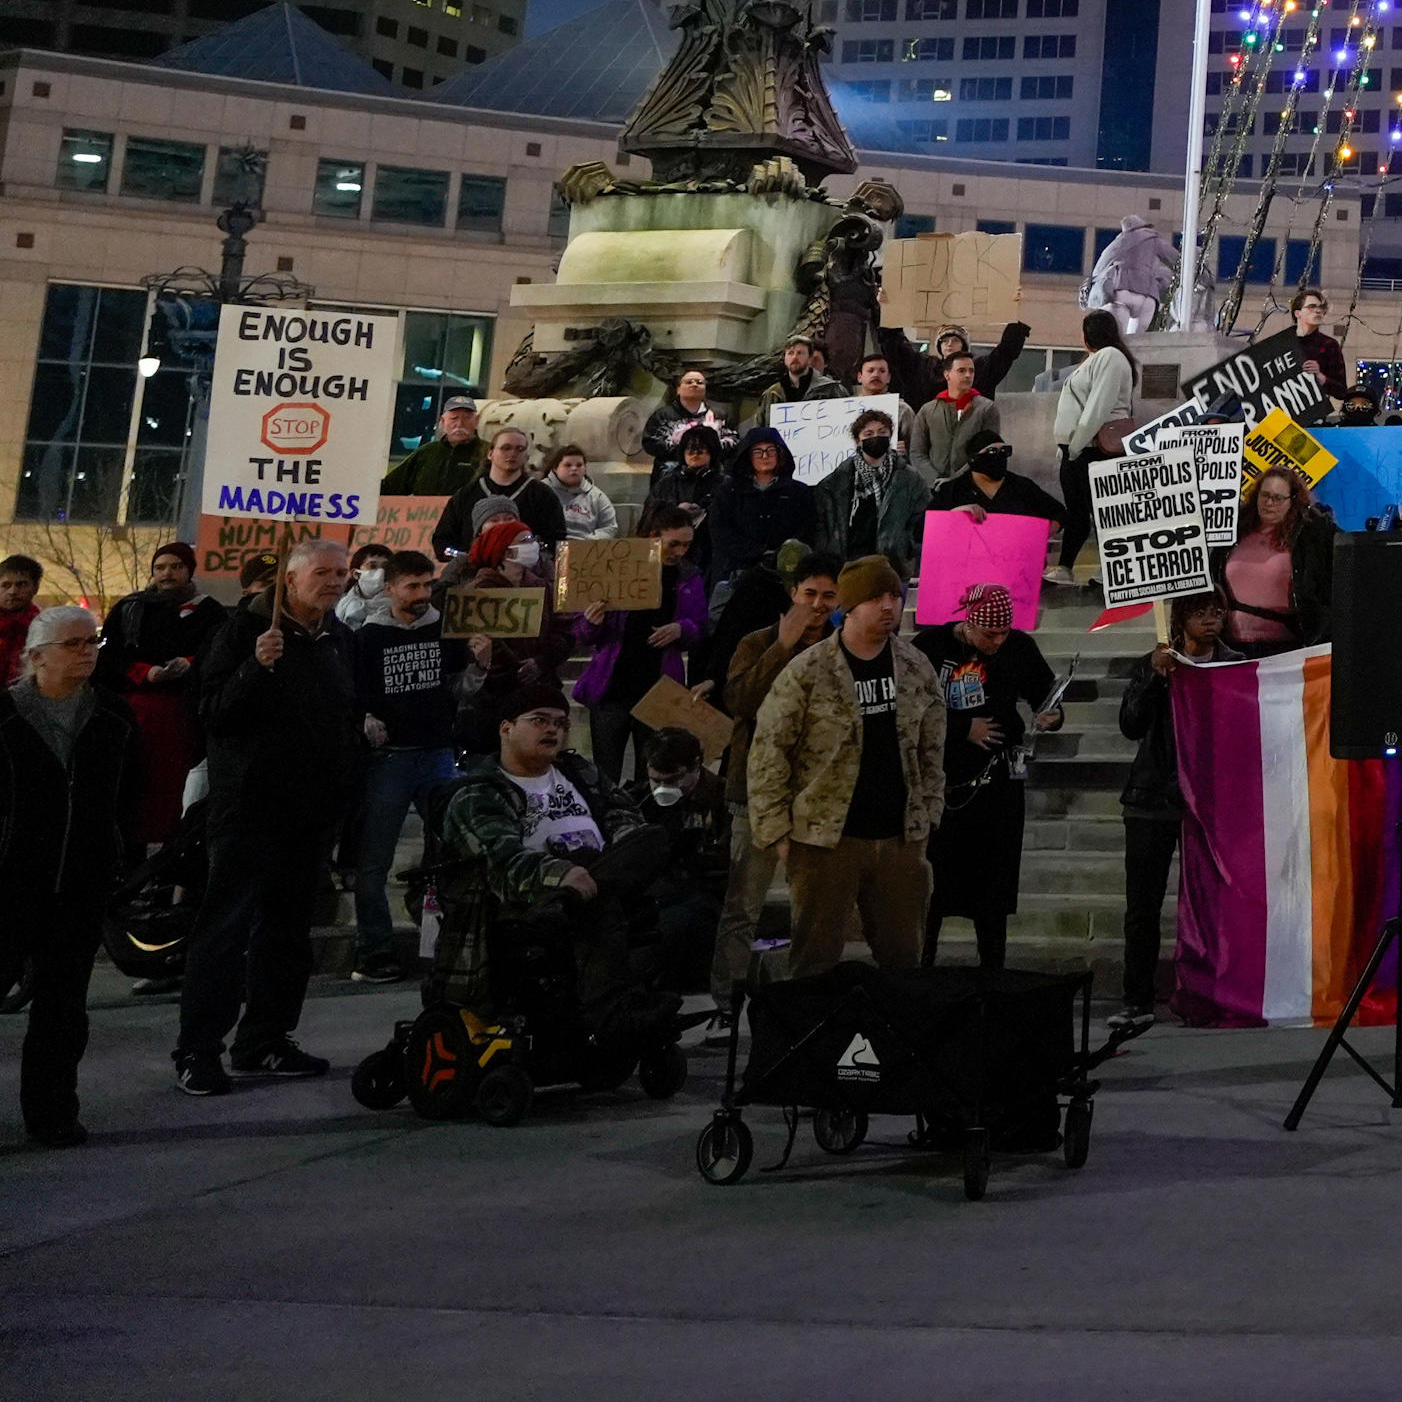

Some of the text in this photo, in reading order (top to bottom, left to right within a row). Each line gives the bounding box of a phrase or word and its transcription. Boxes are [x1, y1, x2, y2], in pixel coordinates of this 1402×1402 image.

[900, 236, 1011, 290] FUCK
[915, 287, 990, 327] ICE
[238, 311, 375, 349] ENOUGH
[277, 348, 314, 373] IS
[1263, 351, 1297, 378] THE
[233, 369, 369, 401] ENOUGH
[270, 418, 320, 436] STOP
[1182, 429, 1219, 437] FROM
[249, 458, 323, 485] THE
[1119, 456, 1163, 471] FROM
[1094, 461, 1193, 499] INDIANAPOLIS
[218, 485, 361, 519] MADNESS
[1134, 491, 1156, 502] TO
[1098, 491, 1197, 530] MINNEAPOLIS
[584, 539, 632, 560] NO
[1103, 525, 1201, 557] STOP
[1106, 547, 1205, 587] ICE TERROR
[576, 579, 650, 599] POLICE
[1109, 577, 1206, 603] PARTY FOR SOCIALISM & LIBERATION
[383, 643, 418, 655] IMAGINE
[384, 648, 441, 665] SCARED OF
[384, 658, 442, 676] DIVERSITY
[384, 668, 442, 687] BUT NOT
